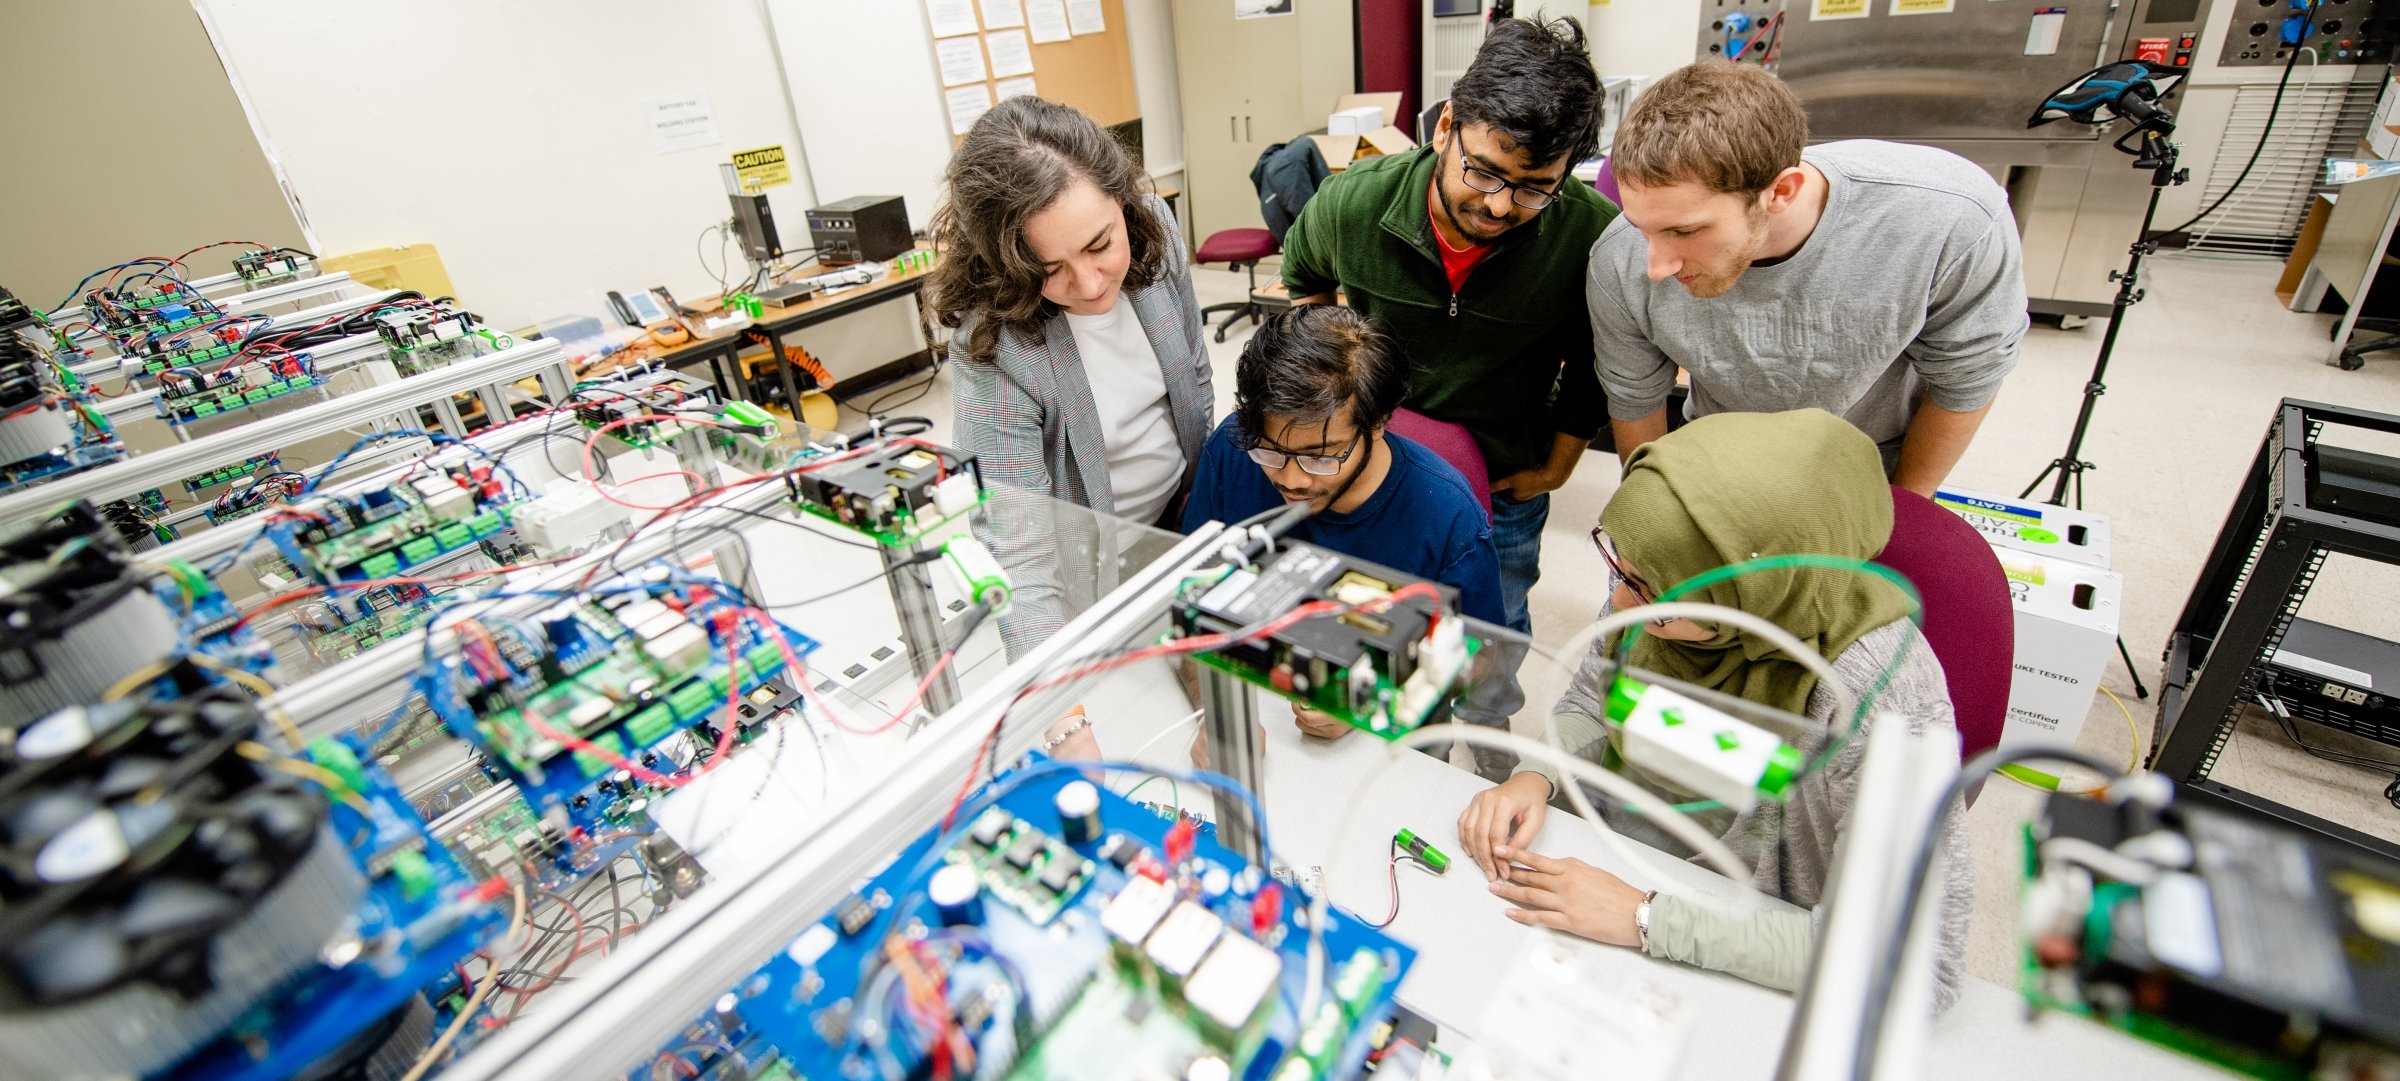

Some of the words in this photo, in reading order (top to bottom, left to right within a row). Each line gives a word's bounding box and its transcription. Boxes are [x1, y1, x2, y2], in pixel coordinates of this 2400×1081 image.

[1820, 6, 1861, 14] explosion
[685, 115, 709, 125] STATION
[735, 148, 784, 169] CAUTION
[1966, 498, 2006, 511] CAT6
[2014, 663, 2036, 674] UKE
[2038, 669, 2079, 685] TESTED
[2010, 707, 2059, 725] certified
[2018, 716, 2057, 732] COPPER
